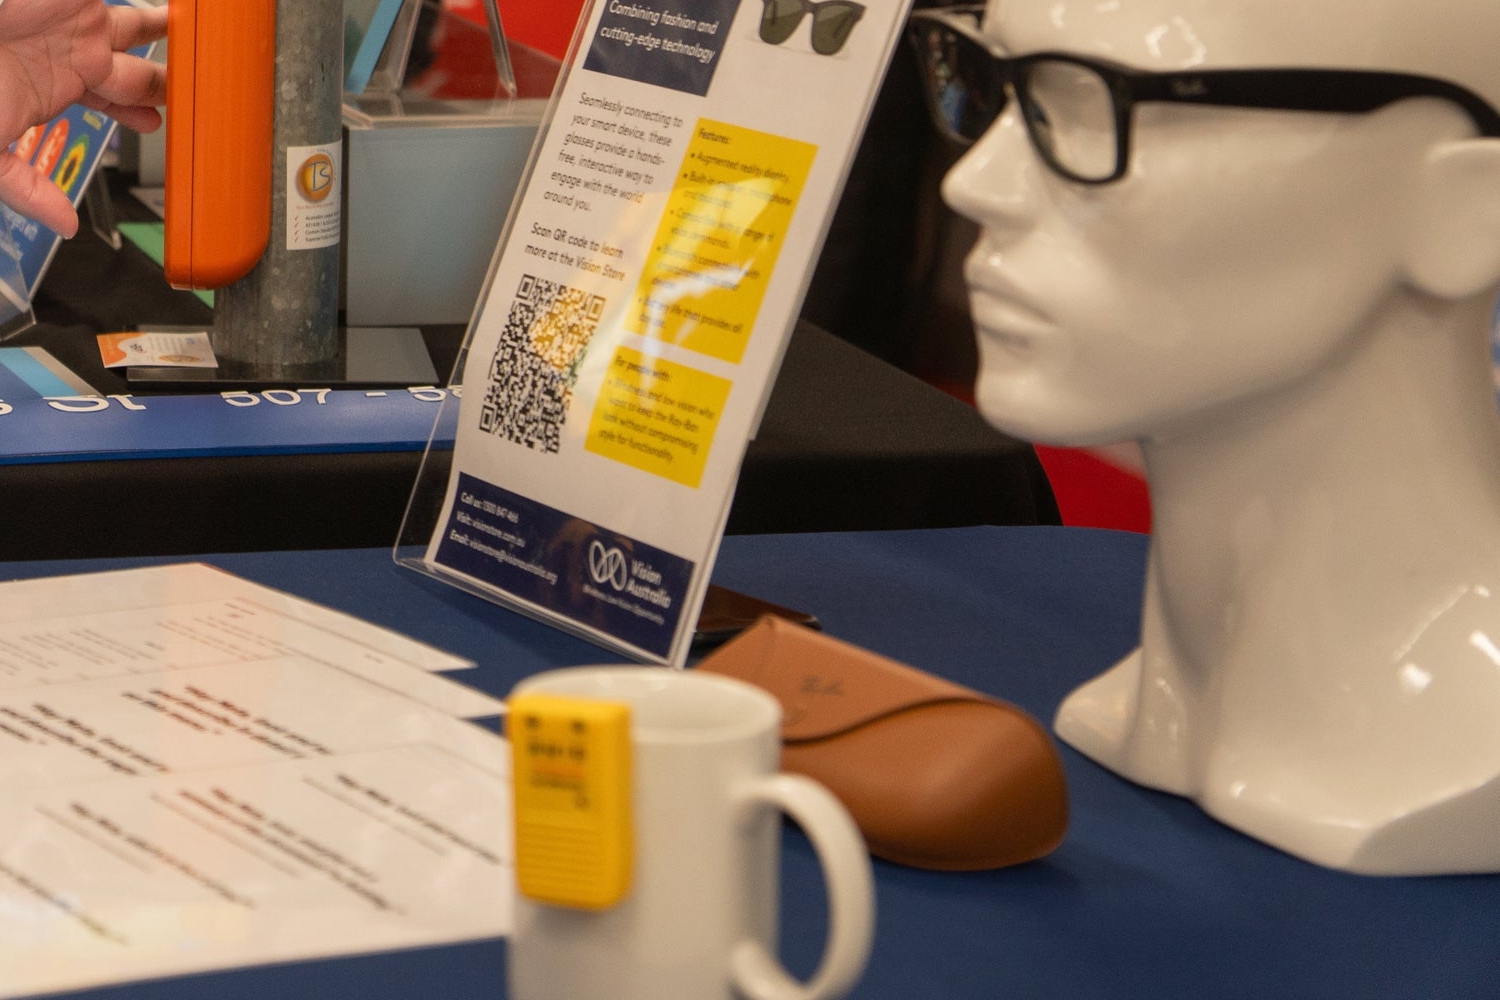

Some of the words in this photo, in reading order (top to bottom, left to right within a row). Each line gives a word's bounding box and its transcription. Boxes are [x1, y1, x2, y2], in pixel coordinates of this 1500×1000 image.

[609, 0, 660, 27] Combining
[661, 10, 697, 29] fashion
[697, 20, 720, 35] and
[600, 26, 661, 51] cutting-edge
[661, 38, 716, 64] technology
[579, 92, 623, 116] Seamlessly
[624, 105, 673, 128] connecting
[673, 116, 684, 128] to
[570, 114, 592, 126] your
[592, 119, 617, 132] smart
[617, 123, 646, 143] device,
[649, 131, 673, 147] these
[563, 131, 595, 148] glasses
[594, 141, 628, 158] provide
[636, 150, 666, 166] hands-
[696, 152, 739, 171] Augmented
[557, 149, 577, 167] free,
[578, 154, 624, 177] interactive
[625, 171, 642, 185] way
[644, 173, 654, 185] to
[543, 190, 574, 207] around
[551, 171, 582, 189] engage
[582, 178, 603, 192] with
[603, 183, 619, 197] the
[619, 190, 645, 204] world
[531, 222, 552, 239] Scan
[553, 228, 568, 243] QR
[568, 235, 589, 249] code
[589, 240, 600, 253] to
[600, 242, 624, 259] learn
[524, 244, 547, 259] more
[547, 250, 559, 262] at
[559, 252, 575, 267] the
[575, 256, 602, 274] Vision
[602, 264, 626, 281] Store
[220, 386, 333, 408] 507
[460, 491, 474, 505] Call
[456, 511, 473, 526] Visit:
[449, 529, 470, 546] Email:
[631, 559, 662, 586] Vision
[625, 578, 672, 609] Australia
